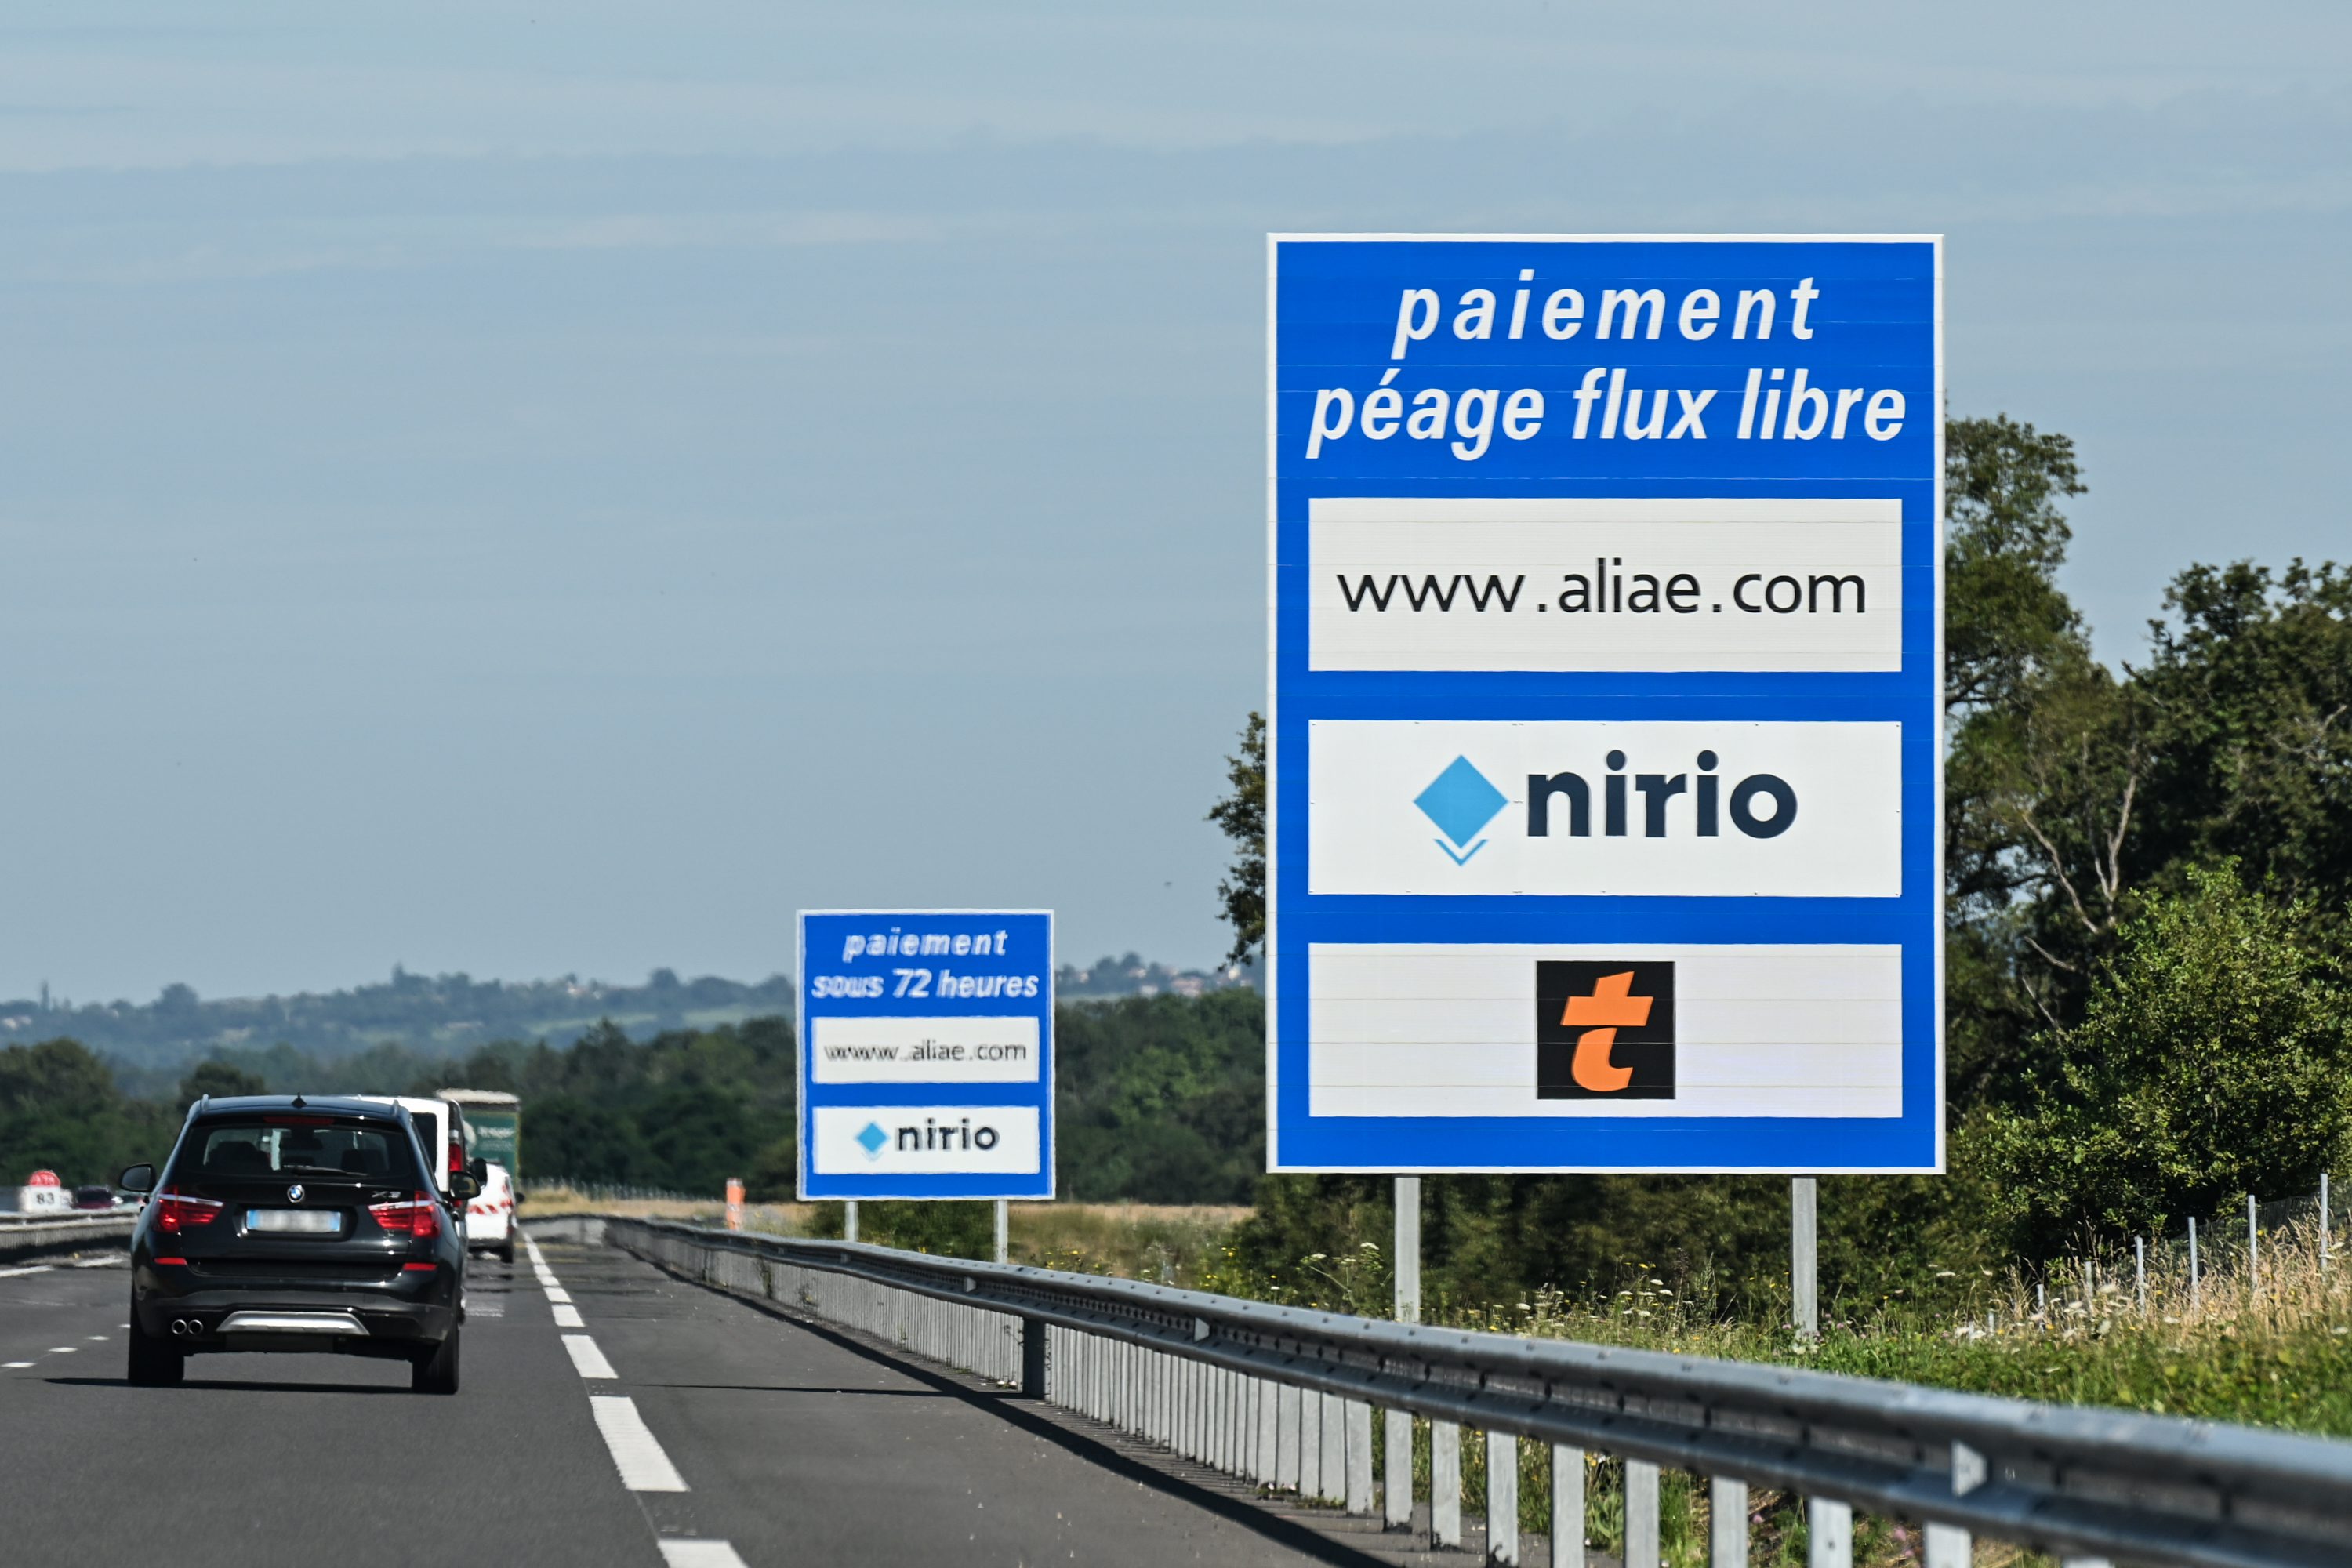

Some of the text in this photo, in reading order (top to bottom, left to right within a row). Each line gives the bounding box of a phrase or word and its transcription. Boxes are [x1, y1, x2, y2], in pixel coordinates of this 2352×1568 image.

[1392, 268, 1819, 359] paiement
[1306, 368, 1907, 460] péage flux libre
[1337, 557, 1866, 613] www.aliae.com
[1527, 750, 1798, 839] nirio
[843, 927, 1008, 962] paiement
[811, 968, 1039, 997] sous 72 heures
[895, 1117, 1000, 1151] nirio
